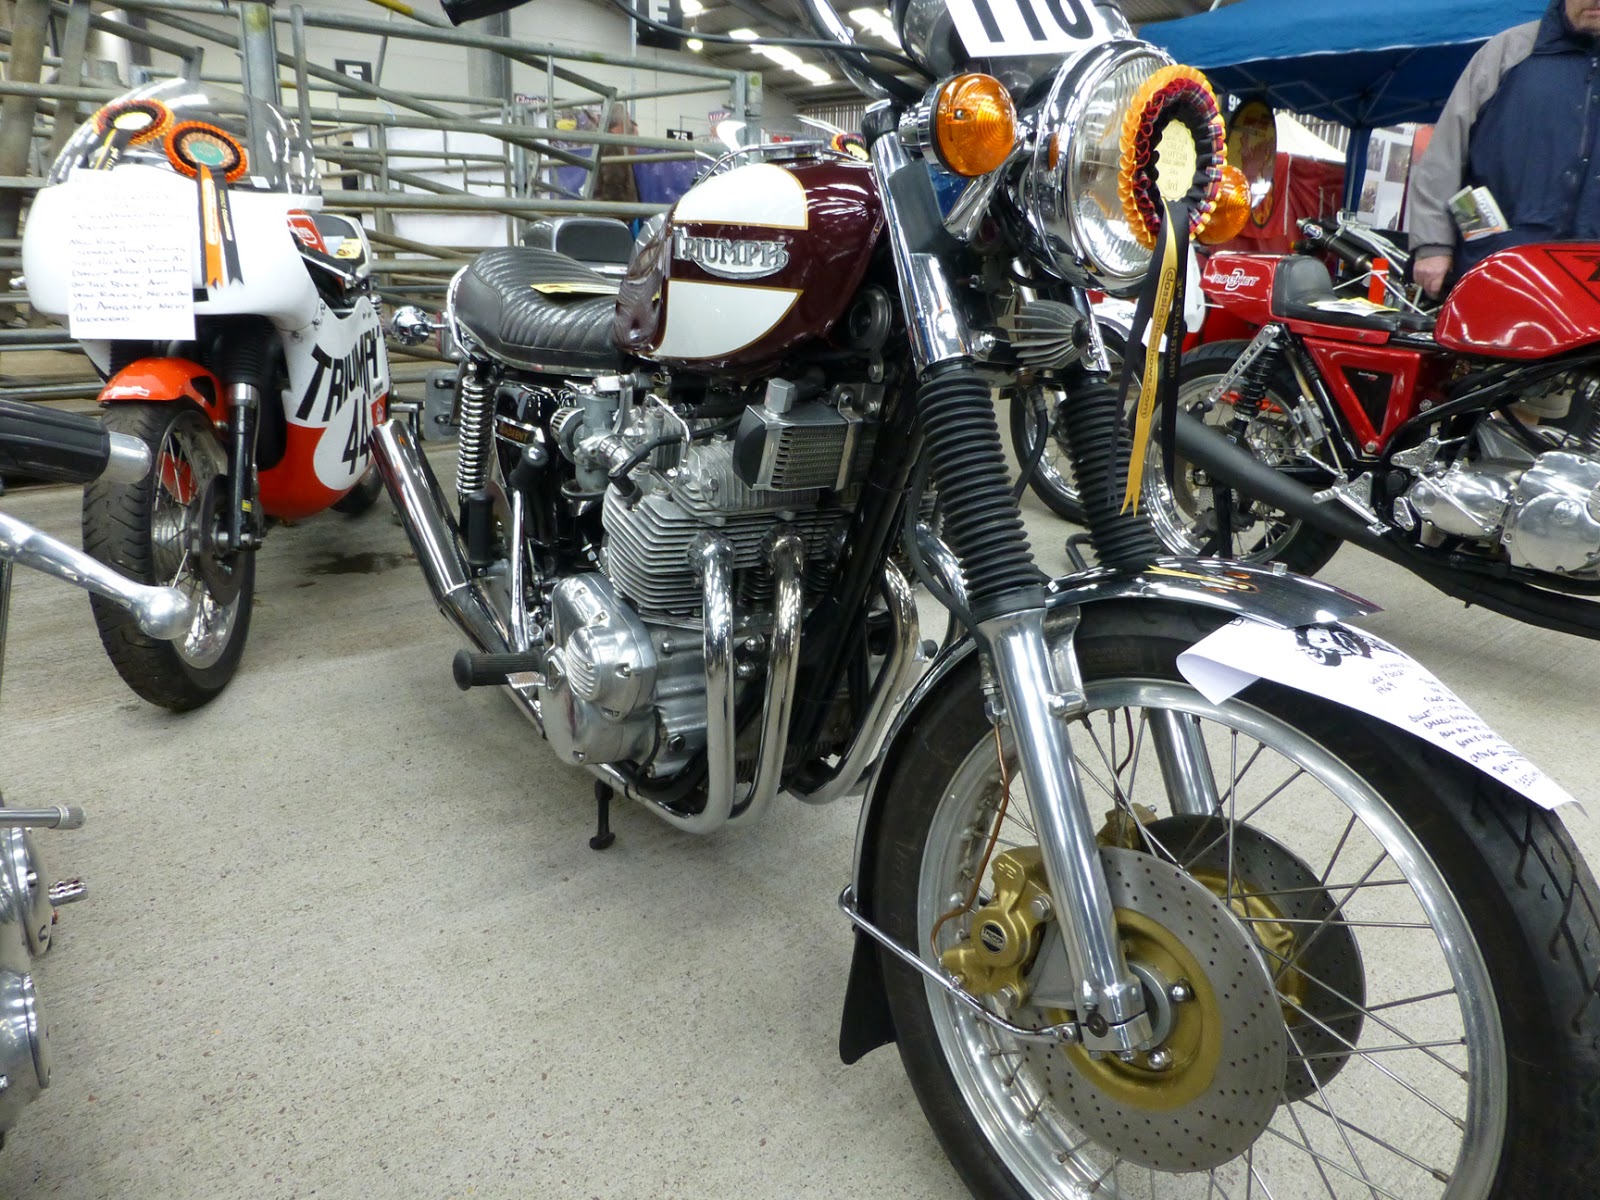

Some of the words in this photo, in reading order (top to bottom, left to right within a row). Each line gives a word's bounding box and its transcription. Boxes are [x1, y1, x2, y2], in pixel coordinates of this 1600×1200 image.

[673, 226, 790, 279] TRIUMPH
[295, 325, 380, 422] TRIUMPH
[342, 392, 371, 475] 44
